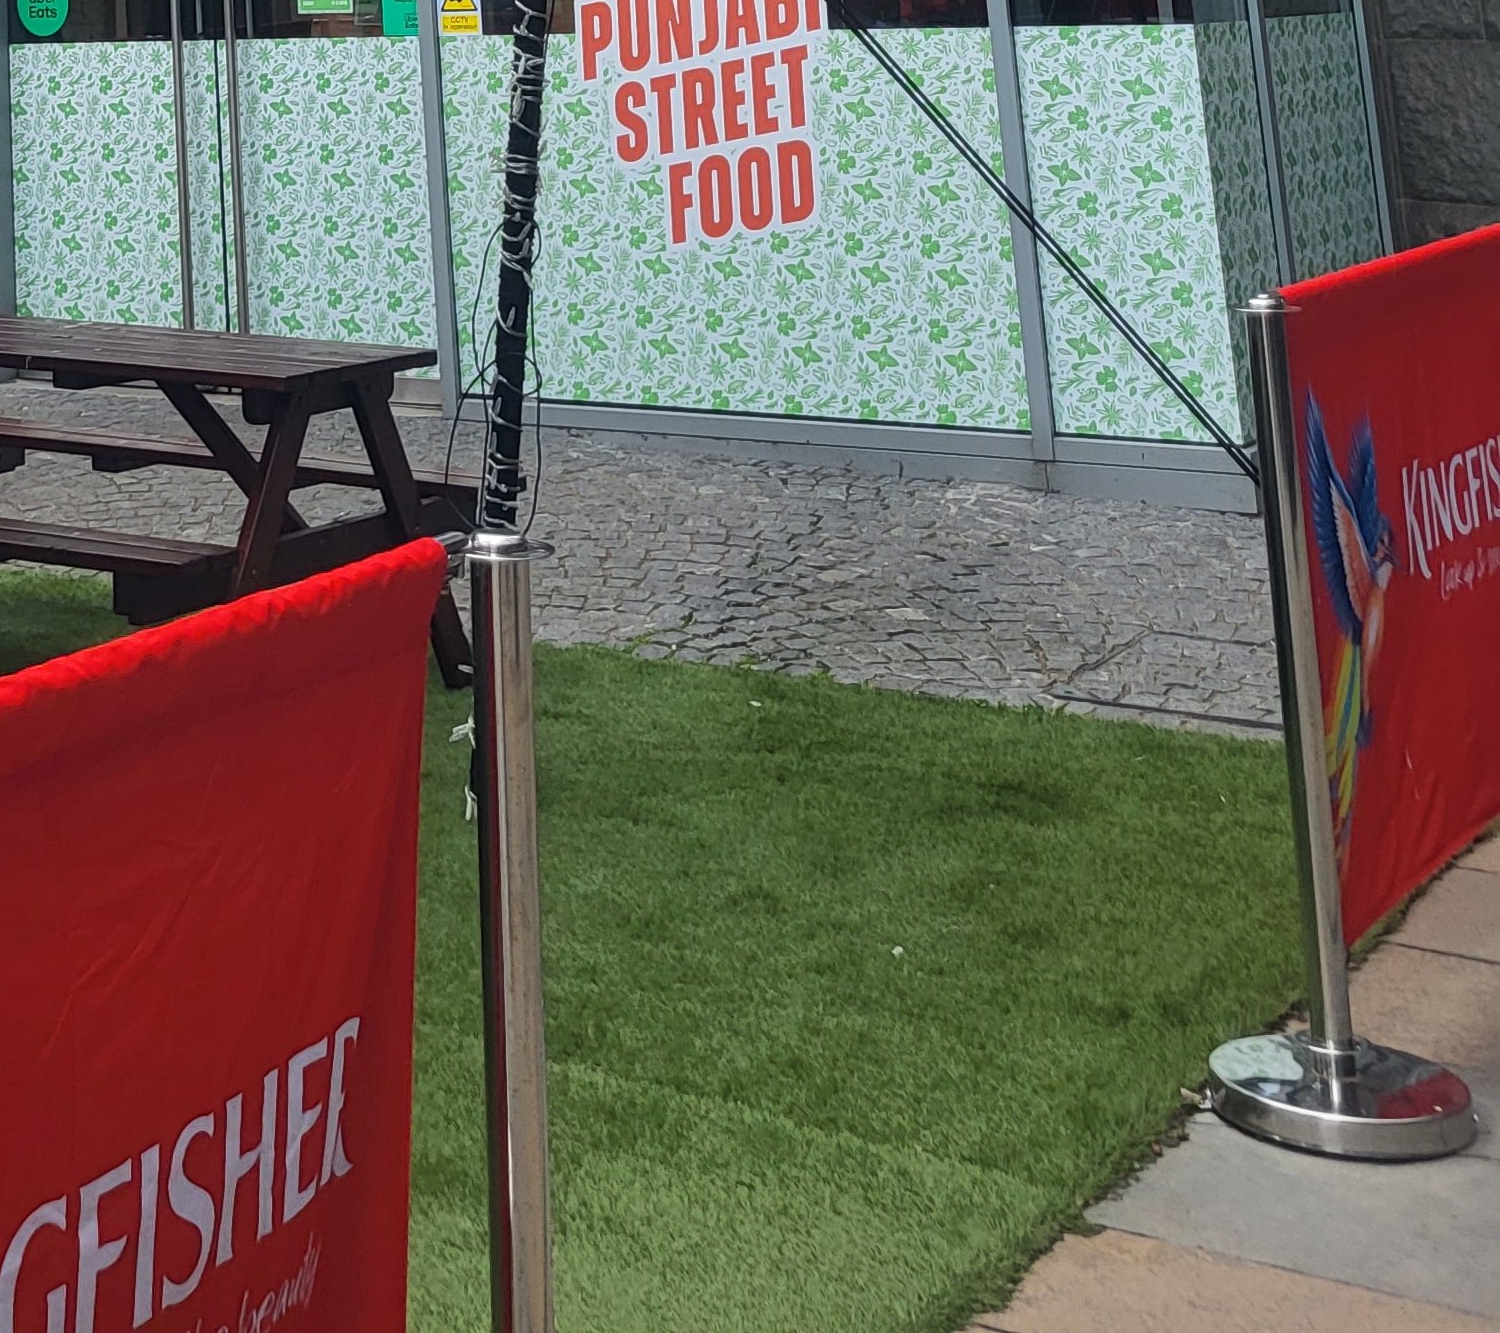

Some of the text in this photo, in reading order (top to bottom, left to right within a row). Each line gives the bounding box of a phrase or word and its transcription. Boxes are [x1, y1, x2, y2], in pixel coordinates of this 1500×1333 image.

[28, 5, 58, 19] Eats
[613, 43, 809, 163] STREET
[668, 138, 815, 245] FOOD
[1401, 435, 1500, 579] KINGFIS
